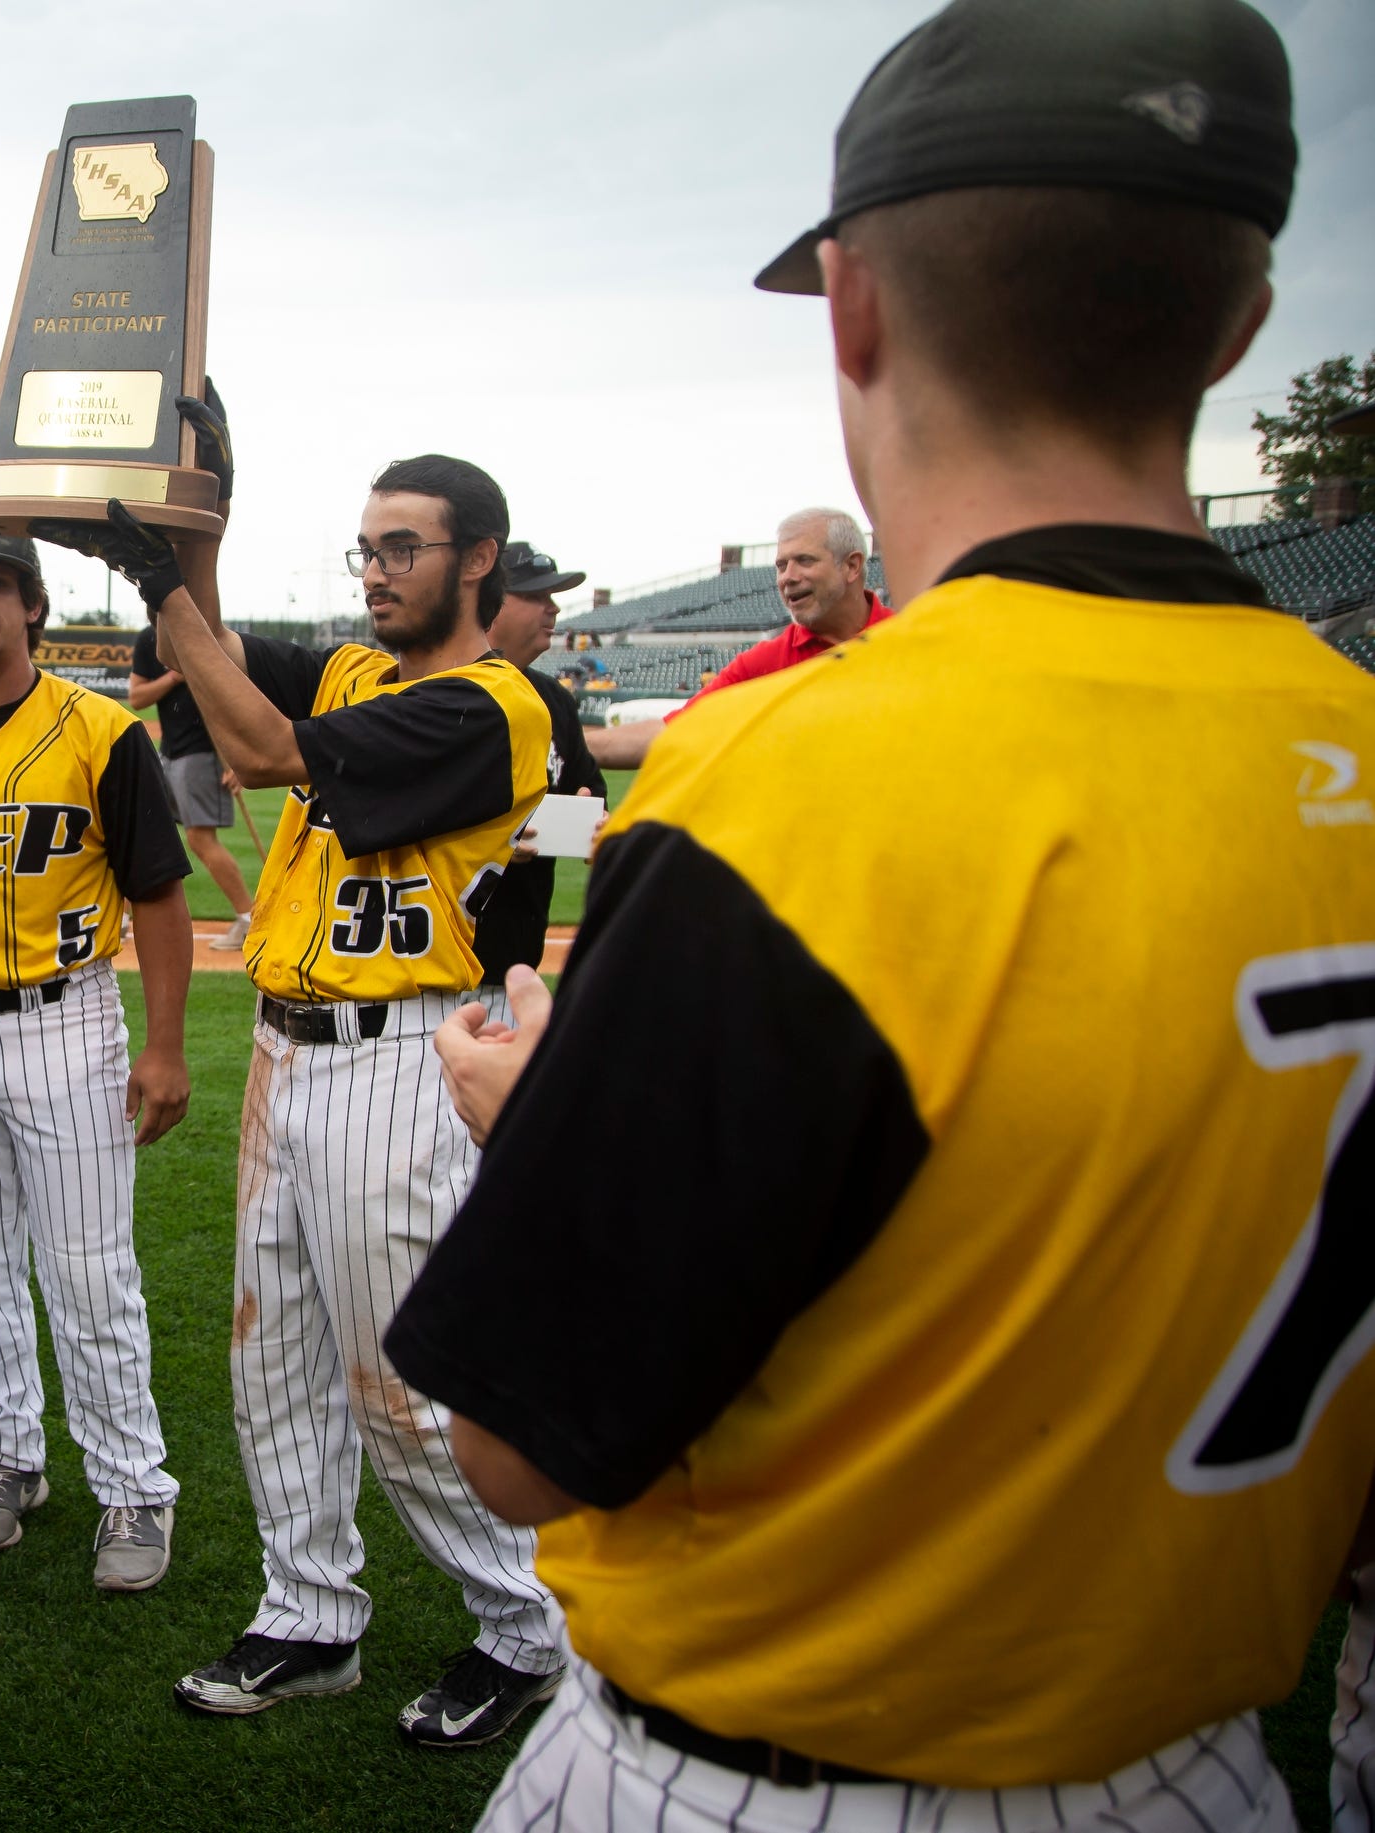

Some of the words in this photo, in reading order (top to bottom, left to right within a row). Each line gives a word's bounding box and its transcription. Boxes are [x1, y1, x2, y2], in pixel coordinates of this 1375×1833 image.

[80, 152, 146, 212] IHSAA
[71, 290, 132, 309] STATE
[32, 314, 167, 334] PARTICIPANT
[78, 381, 103, 394] 2019
[57, 397, 119, 409] BASEBALL
[38, 412, 134, 426] QUARTERFINAL
[328, 874, 435, 960] 35
[56, 903, 101, 969] 5
